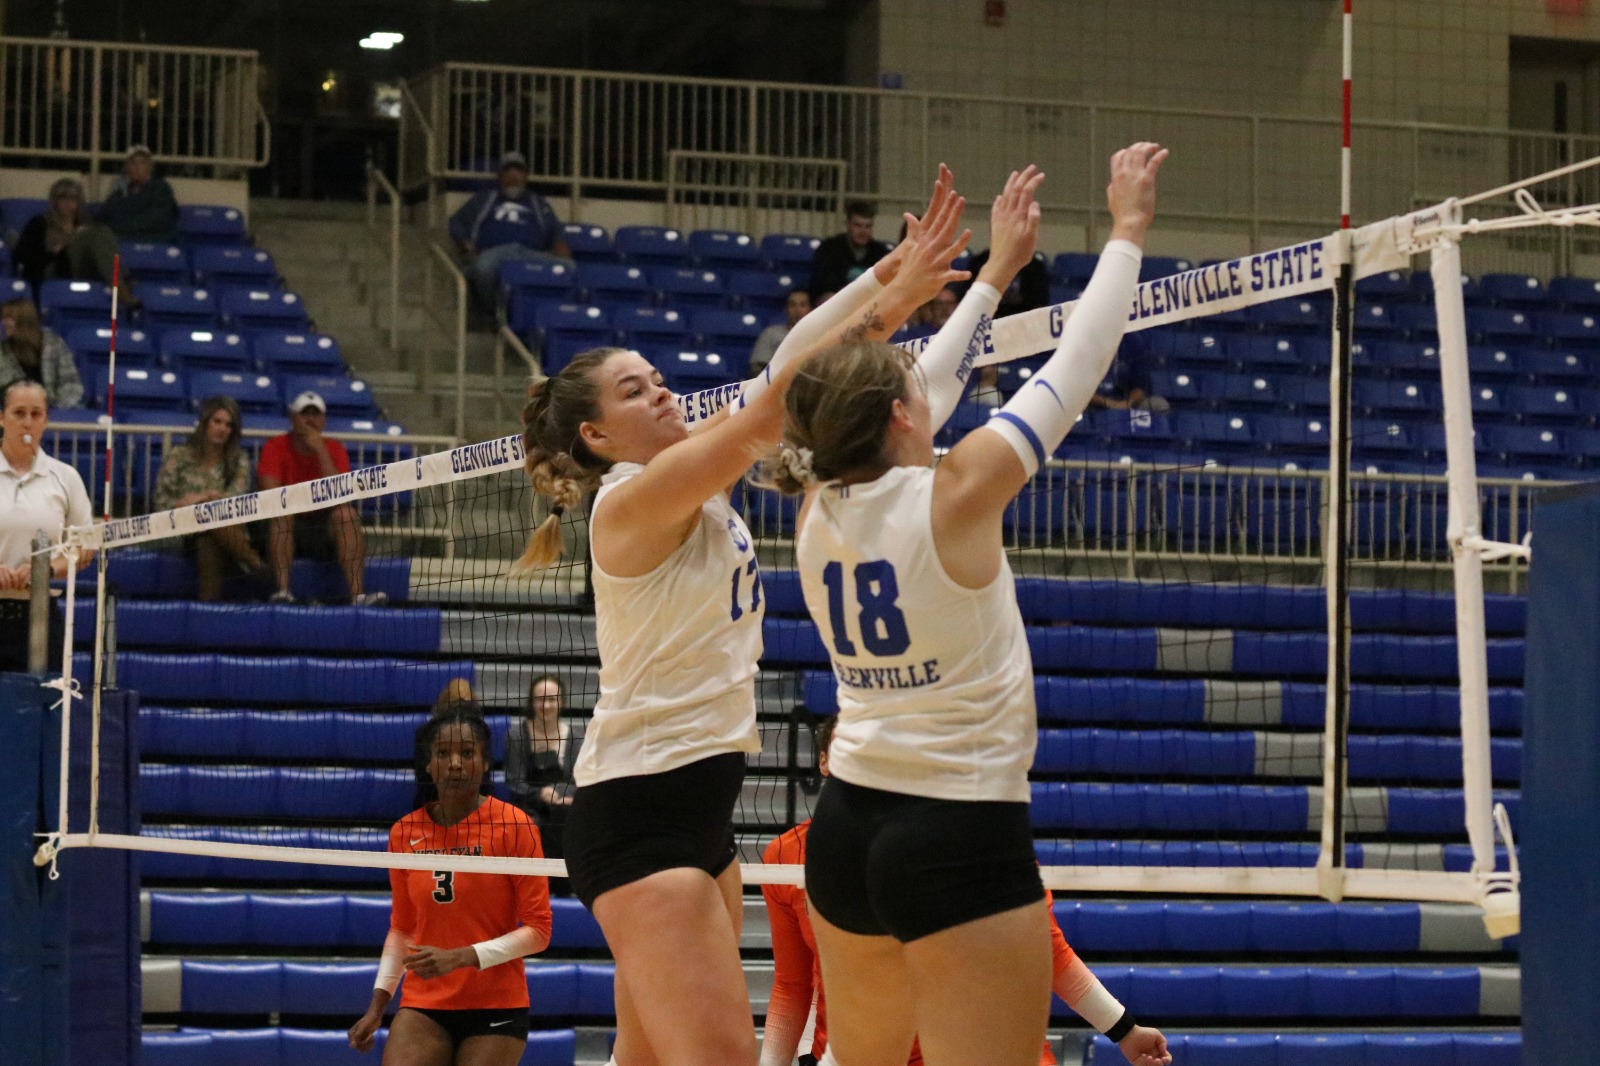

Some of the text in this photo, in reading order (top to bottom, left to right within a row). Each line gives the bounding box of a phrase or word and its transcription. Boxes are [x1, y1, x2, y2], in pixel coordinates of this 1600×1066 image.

[1251, 241, 1324, 292] STATE
[1050, 305, 1063, 339] G
[956, 313, 991, 385] PIONEERS
[699, 383, 740, 420] STATE
[451, 438, 509, 474] GLENVILLE
[357, 465, 387, 492] STATE
[823, 559, 911, 657] 18
[414, 845, 482, 857] LEYAN
[432, 870, 454, 904] 3
